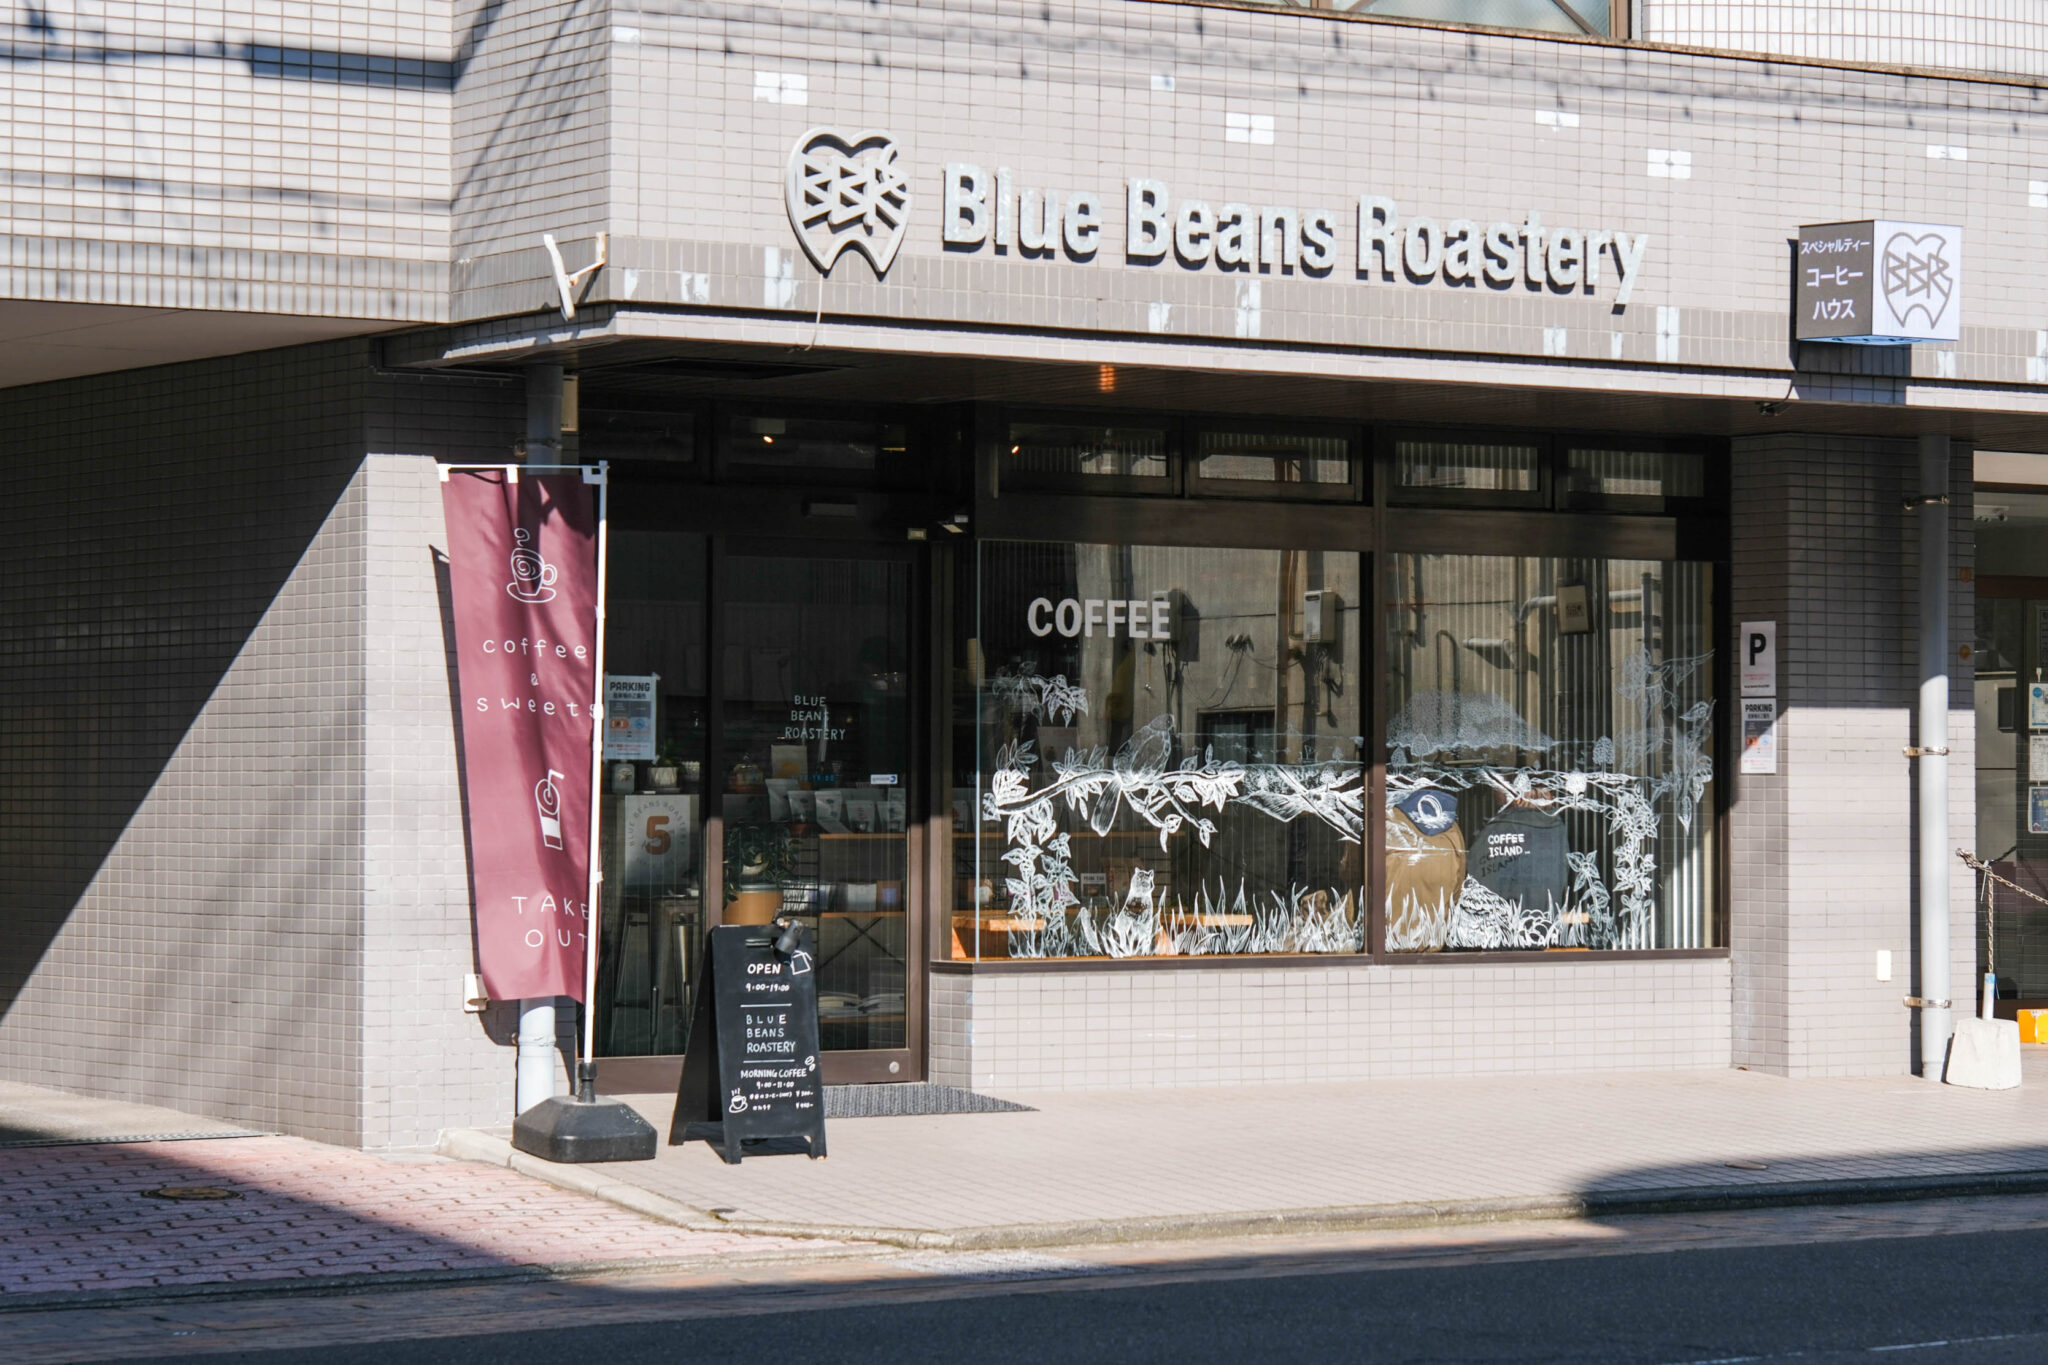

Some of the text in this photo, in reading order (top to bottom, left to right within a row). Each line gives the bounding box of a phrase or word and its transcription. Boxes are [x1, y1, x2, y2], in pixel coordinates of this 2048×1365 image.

[943, 162, 1649, 306] Blue Beans Roastery
[1800, 238, 1870, 255] スペシャルティー
[1806, 265, 1864, 288] コーヒー
[1812, 298, 1856, 320] ハウス
[1027, 597, 1171, 639] COFFEE
[482, 637, 587, 660] coffee
[1749, 633, 1766, 666] P
[530, 672, 539, 686] &
[609, 681, 651, 692] PARKING
[794, 694, 827, 707] BLUE
[1745, 703, 1773, 713] PARKING
[791, 710, 829, 722] BEANS
[785, 726, 846, 741] ROASTERY
[645, 815, 672, 856] 5
[1487, 832, 1525, 845] COFFEE
[511, 895, 588, 920] TAKE
[525, 928, 587, 952] OUT
[746, 963, 782, 975] OPEN
[746, 1014, 787, 1025] BLUE
[746, 1028, 785, 1038] BEANS
[746, 1041, 796, 1054] ROASTERY
[740, 1068, 808, 1079] MORNING COFFEE
